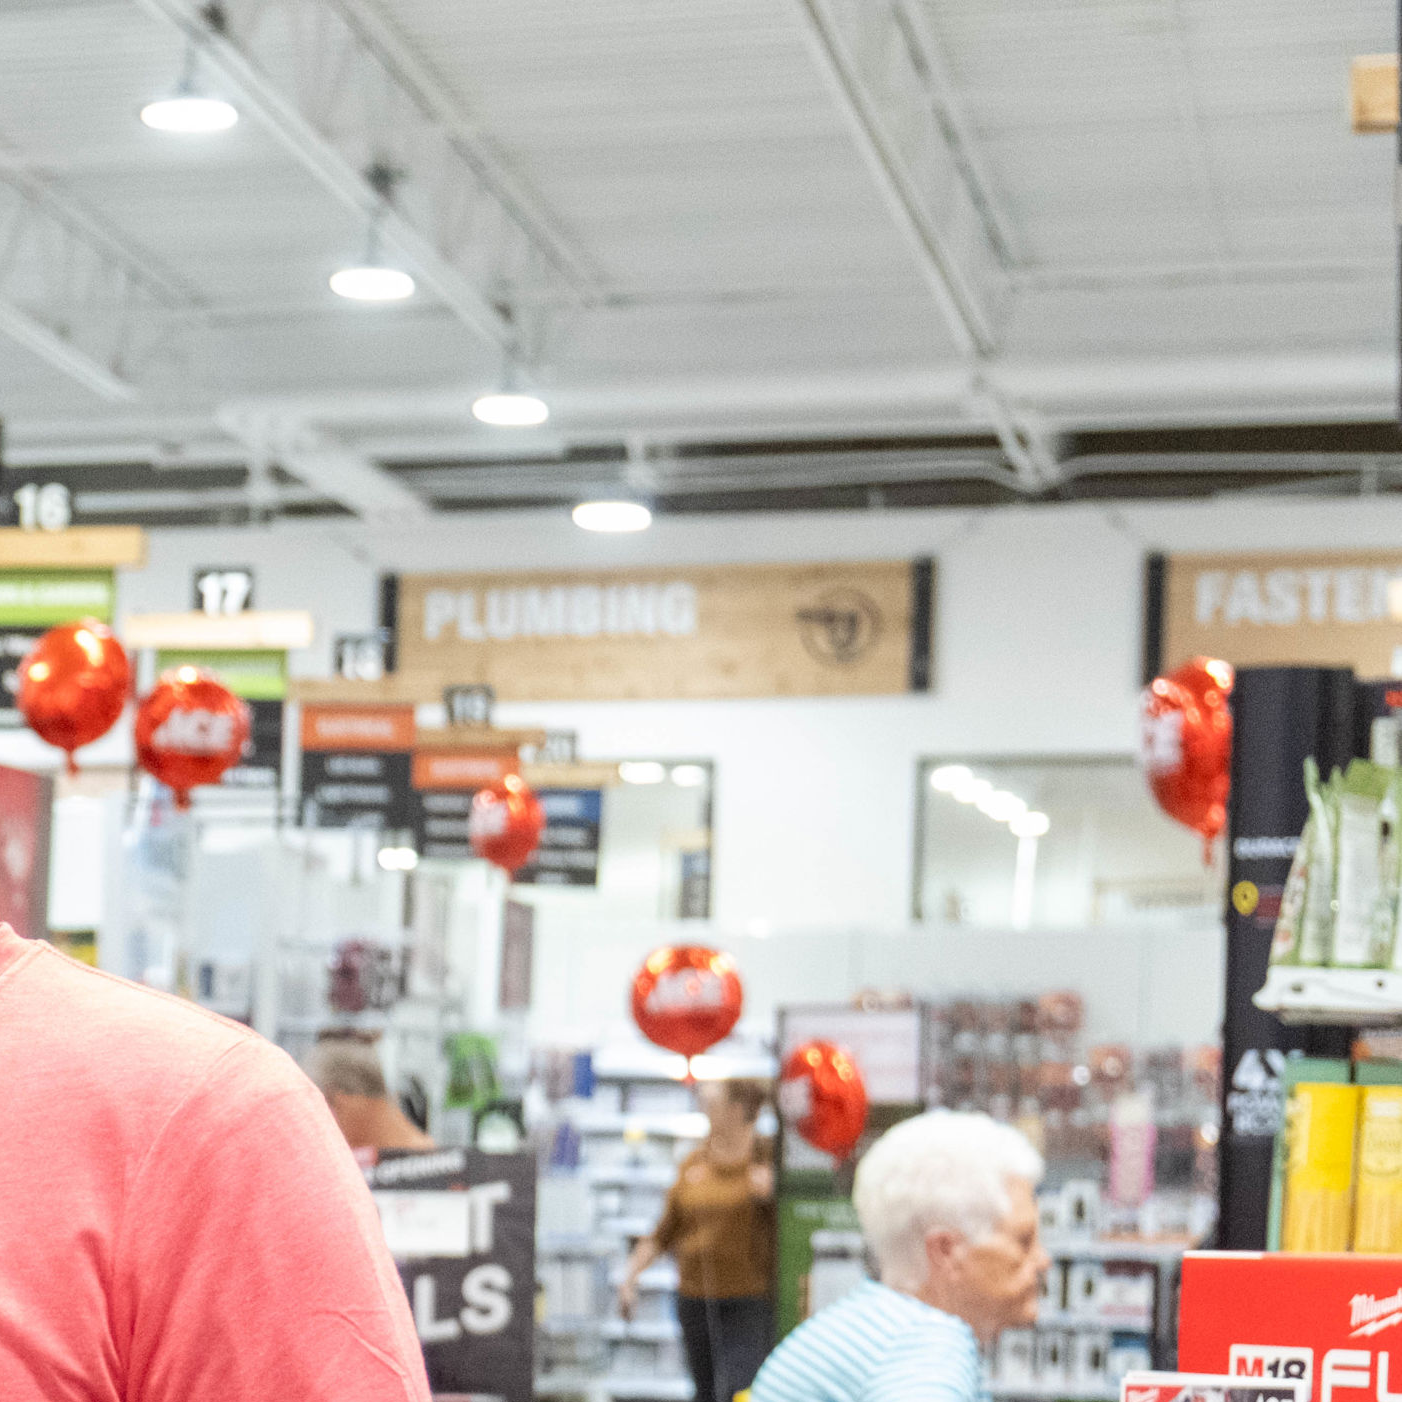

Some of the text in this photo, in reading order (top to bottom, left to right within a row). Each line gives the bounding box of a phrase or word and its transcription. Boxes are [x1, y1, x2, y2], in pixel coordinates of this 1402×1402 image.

[14, 483, 70, 531] 16
[198, 570, 251, 617] 17
[424, 582, 696, 640] PLUMBING
